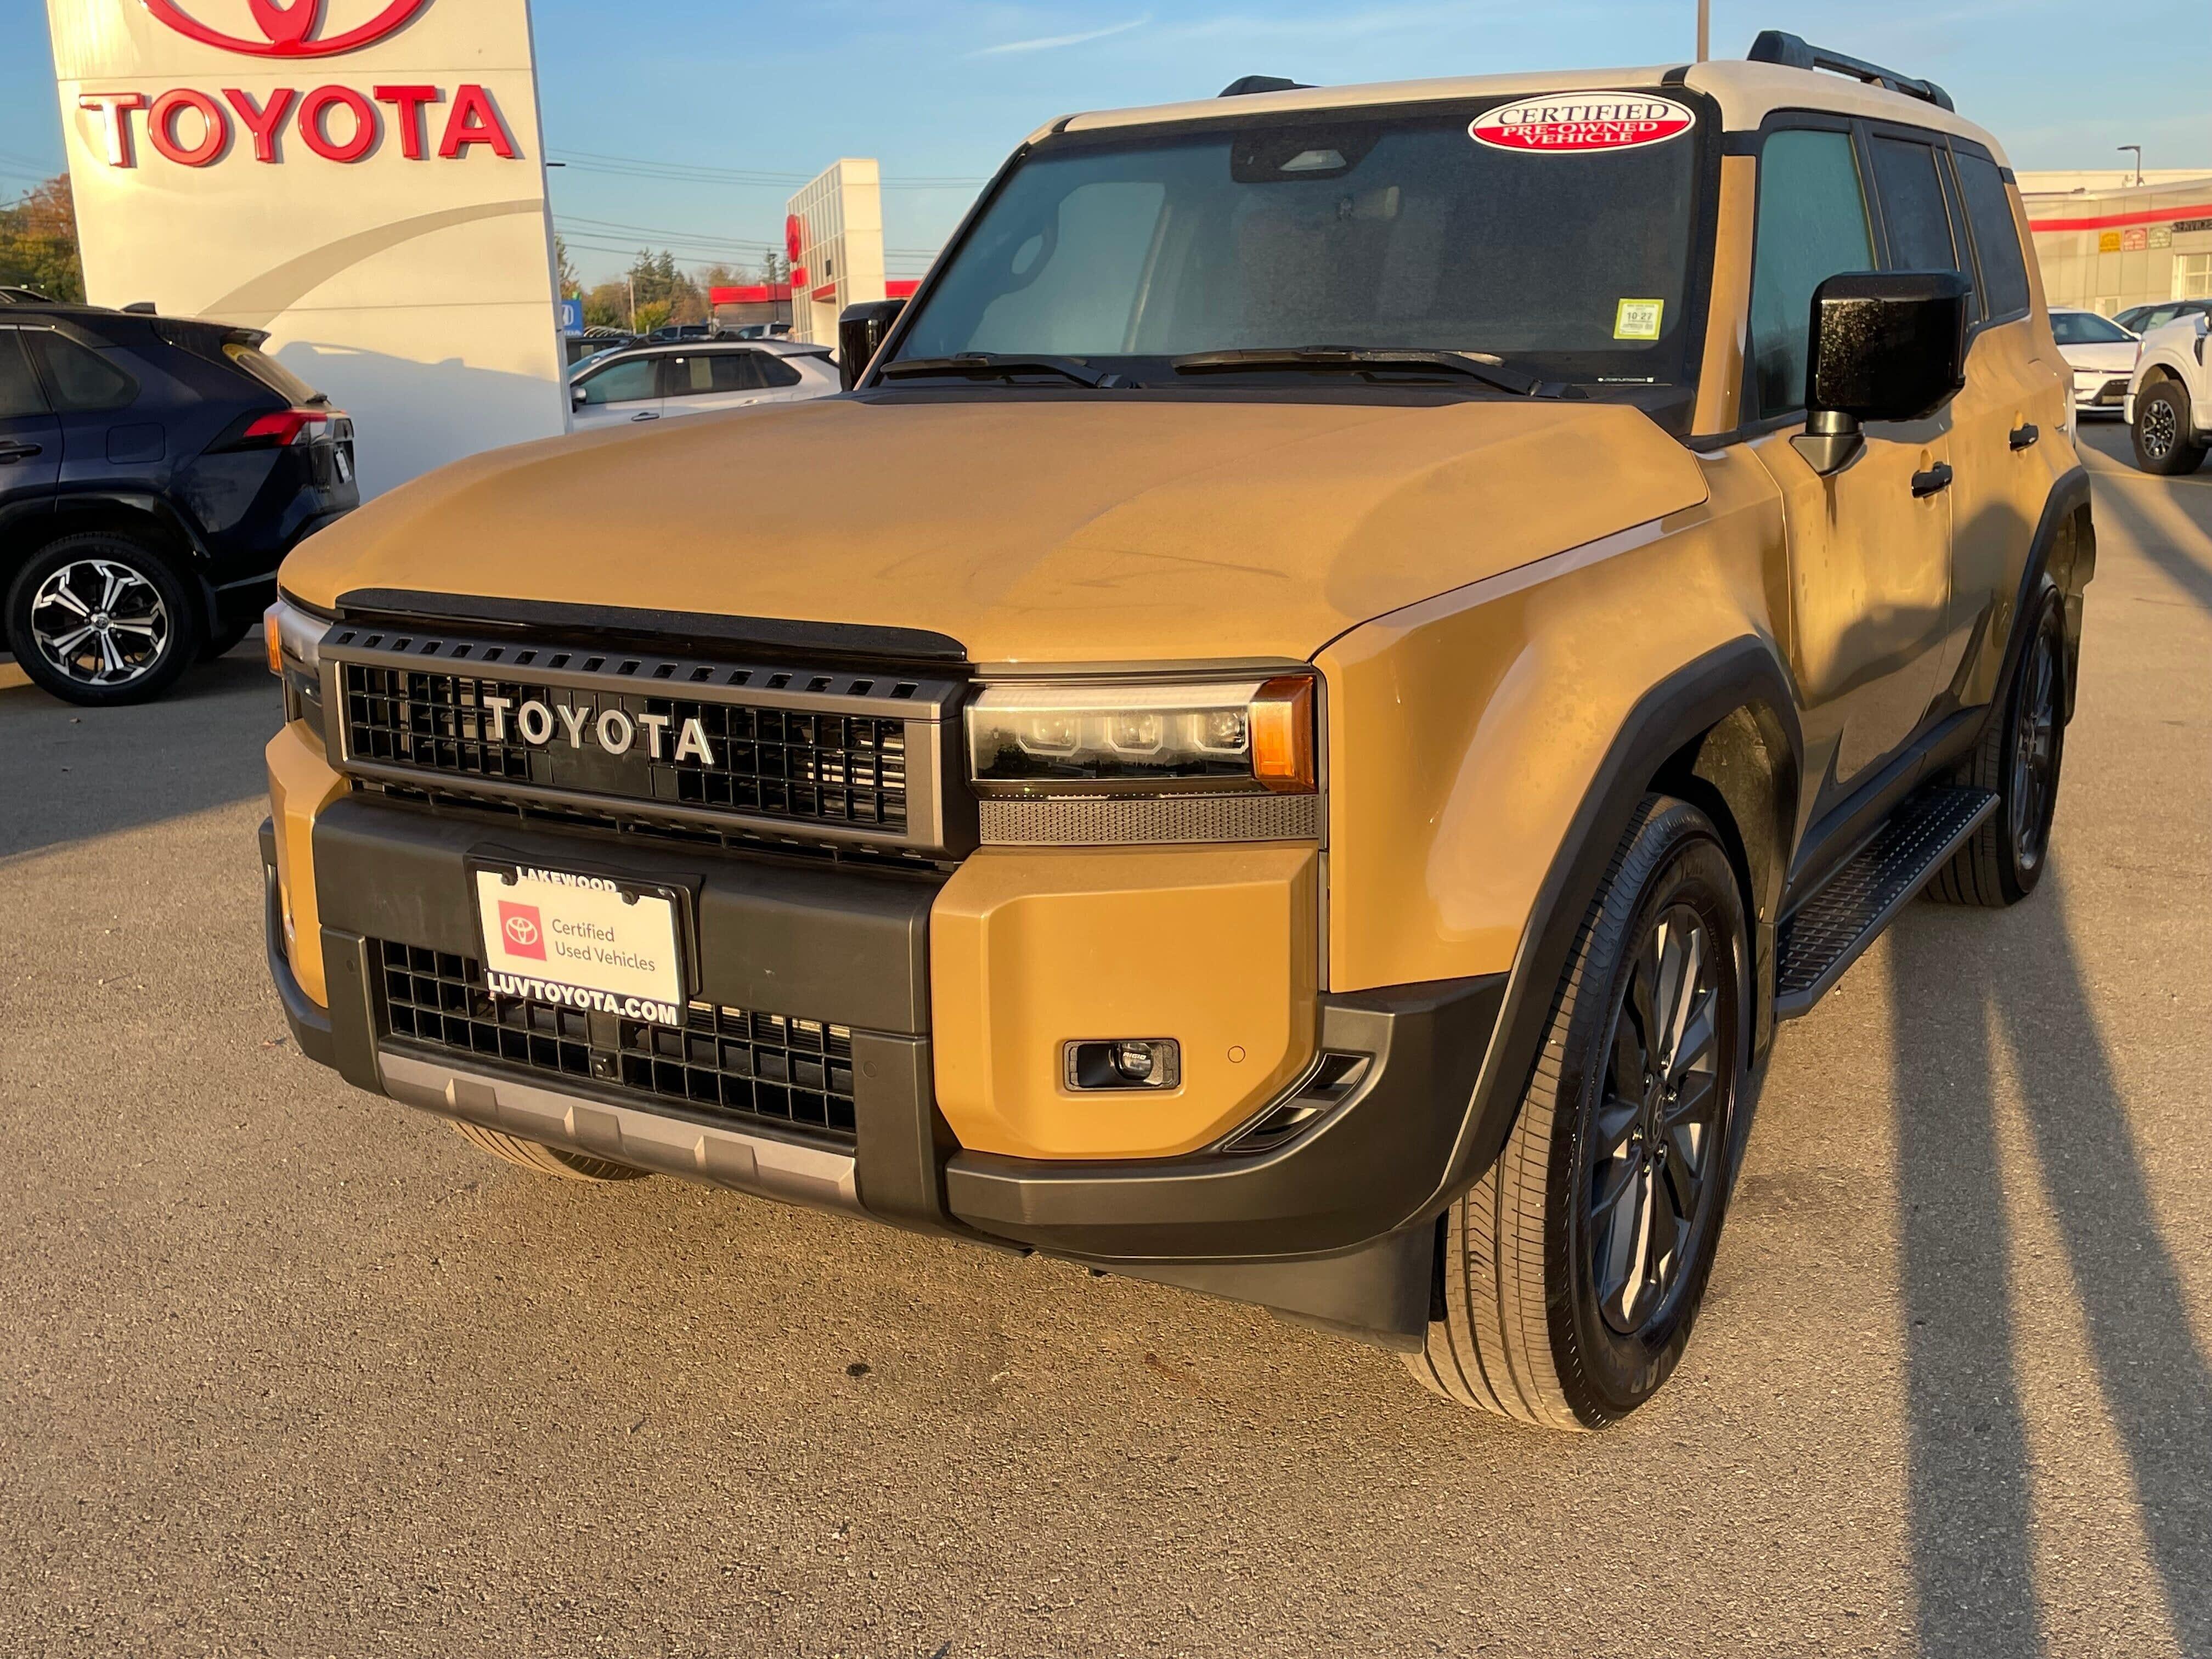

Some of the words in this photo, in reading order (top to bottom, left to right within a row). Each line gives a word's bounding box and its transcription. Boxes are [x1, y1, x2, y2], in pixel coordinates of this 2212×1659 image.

[79, 85, 515, 168] TOYOTA
[1499, 104, 1669, 125] CERTIFIED
[1502, 121, 1658, 137] PRE-OWNED
[1523, 132, 1633, 145] VEHICLE
[1627, 312, 1638, 320] 10
[1641, 312, 1652, 321] 27
[483, 697, 714, 765] TOYOTA
[516, 866, 617, 893] LAKEWOOD
[552, 919, 614, 942] Certified
[555, 941, 591, 961] Used
[594, 948, 655, 972] Vehicles
[487, 973, 677, 1025] LUVTOYOTA.COM
